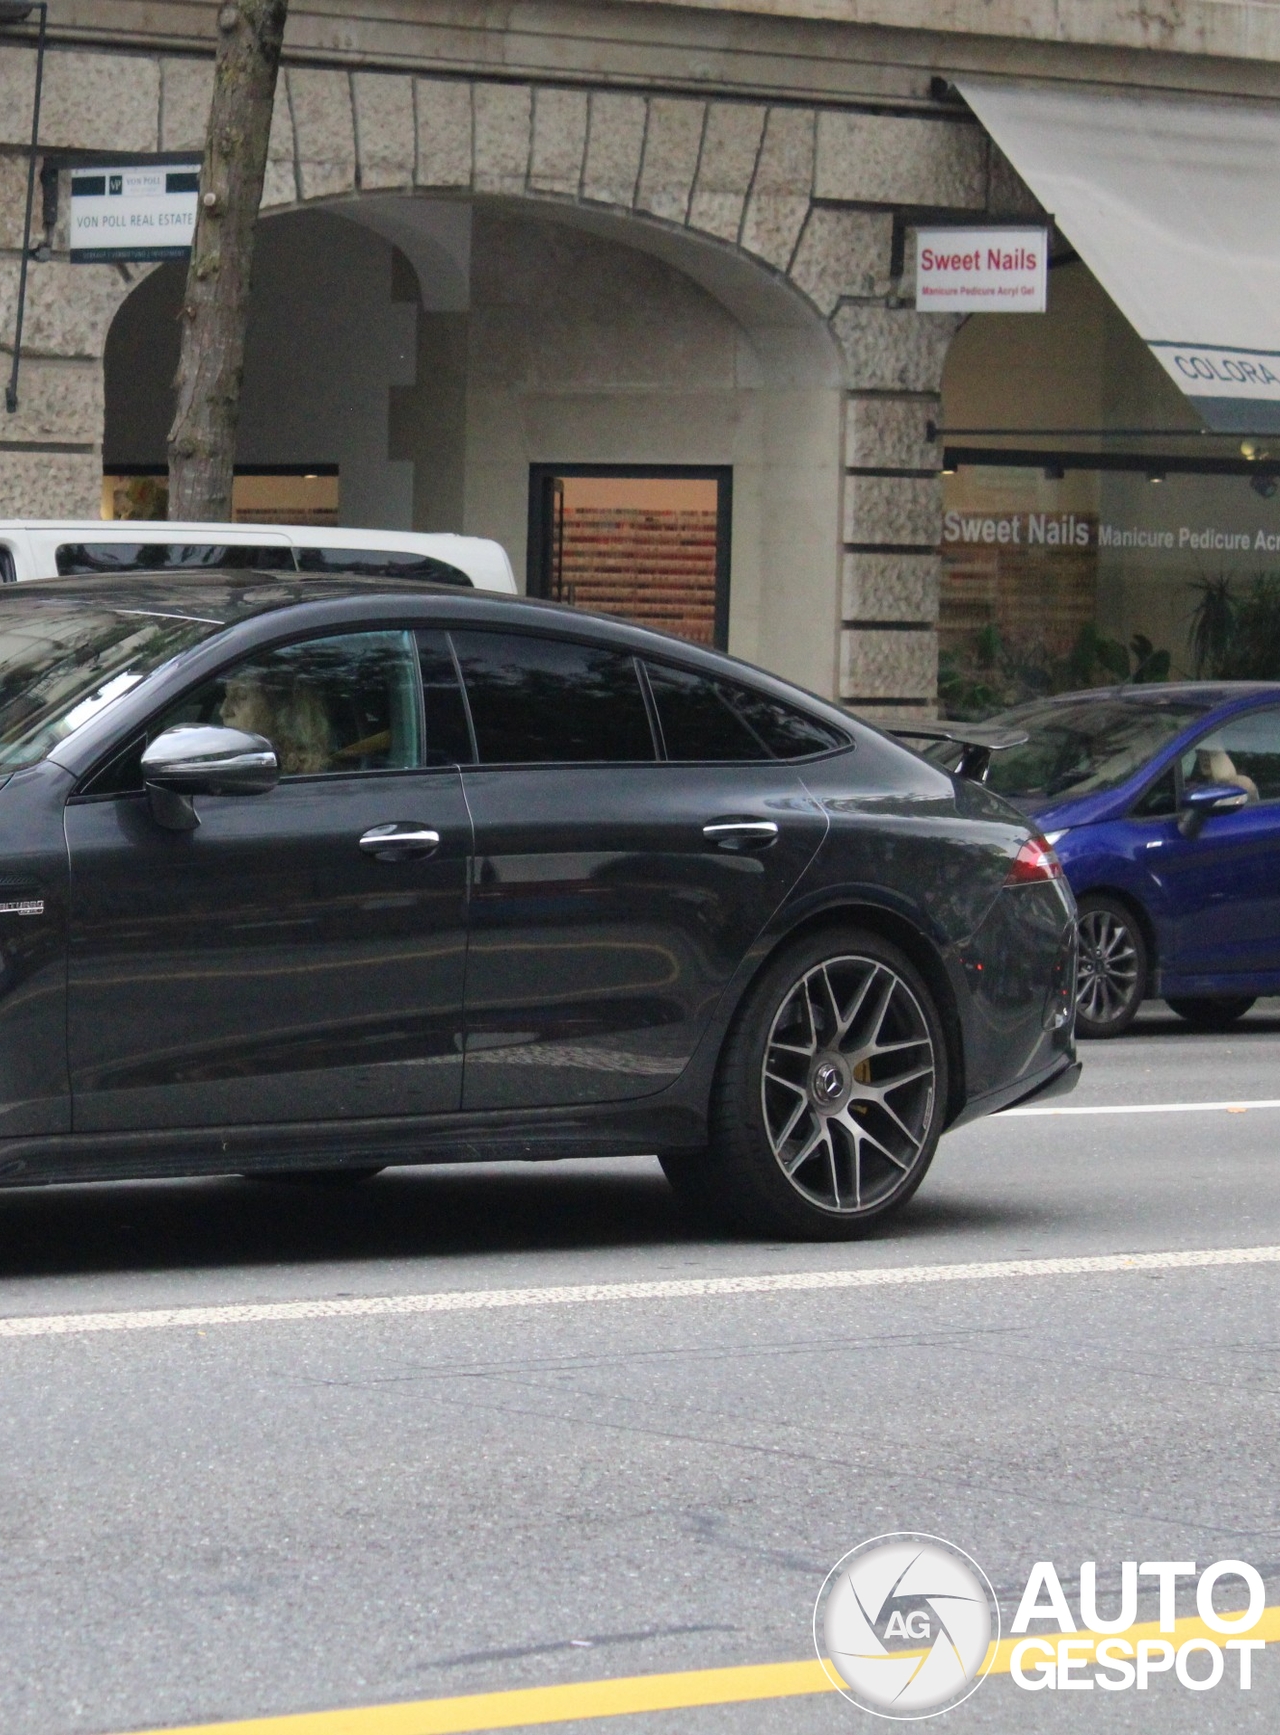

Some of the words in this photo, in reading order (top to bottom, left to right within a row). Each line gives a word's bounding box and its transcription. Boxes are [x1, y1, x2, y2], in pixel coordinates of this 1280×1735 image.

[77, 216, 98, 228] VON
[102, 215, 126, 228] POLL
[130, 213, 154, 226] REAL
[159, 213, 193, 225] ESTATE
[921, 248, 980, 271] Sweet
[987, 248, 1037, 270] Nails
[922, 286, 958, 296] Manicure
[960, 286, 995, 296] Pedicure
[998, 286, 1019, 298] Acryl
[1021, 286, 1035, 296] Gel
[943, 510, 1020, 544] Sweet
[1028, 513, 1089, 546] Nails
[1098, 524, 1175, 549] Manicure
[1178, 526, 1251, 550] Pedicure
